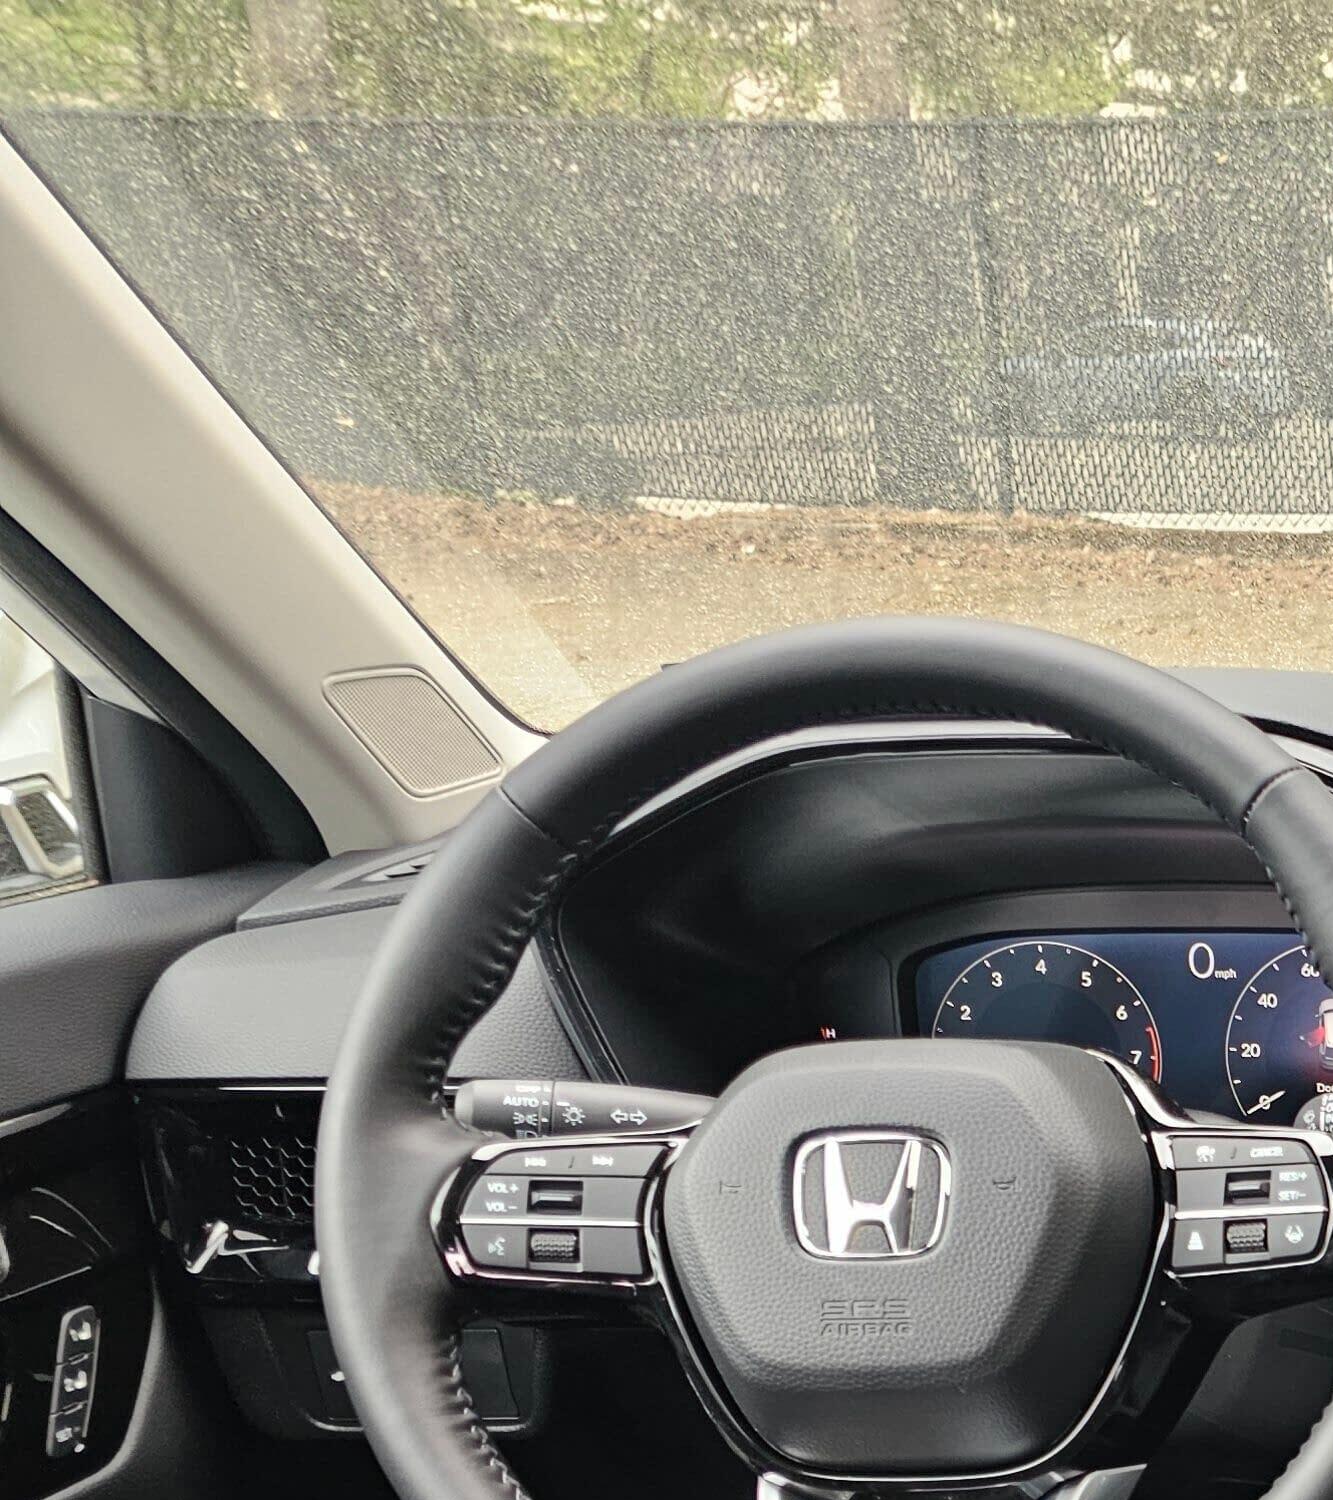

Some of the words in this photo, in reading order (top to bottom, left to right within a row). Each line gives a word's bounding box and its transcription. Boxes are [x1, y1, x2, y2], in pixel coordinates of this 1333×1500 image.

[1034, 959, 1048, 975] 4
[1188, 942, 1215, 979] 0
[1214, 968, 1238, 980] mph
[991, 971, 1003, 988] 3
[1080, 971, 1093, 987] 5
[1257, 993, 1278, 1009] 40
[960, 1005, 972, 1021] 2
[1115, 1005, 1128, 1021] 6
[1130, 1050, 1142, 1065] 7
[1240, 1043, 1261, 1058] 20
[502, 1095, 540, 1107] AUTO
[821, 1321, 913, 1336] AIRBAG
